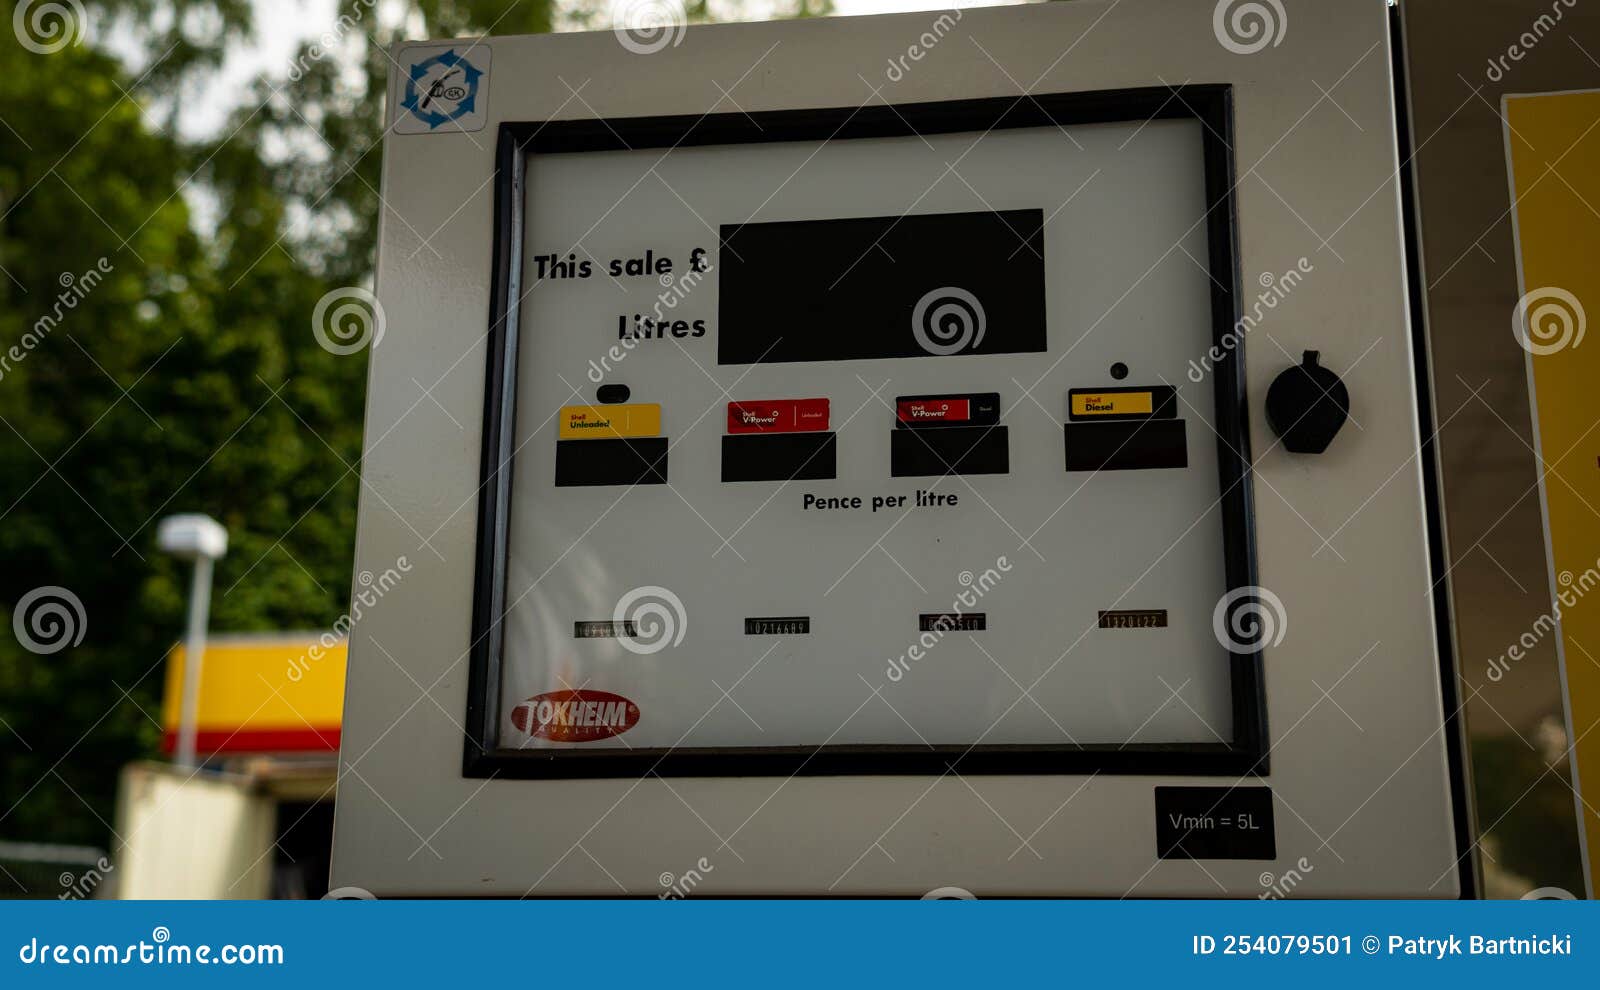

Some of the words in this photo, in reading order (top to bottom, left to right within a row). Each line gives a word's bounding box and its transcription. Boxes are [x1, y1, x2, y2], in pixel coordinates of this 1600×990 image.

[534, 253, 592, 279] This
[609, 250, 672, 277] sale
[618, 314, 706, 340] Litres
[1085, 403, 1113, 411] Diesel
[570, 420, 610, 428] Unleaded
[803, 493, 862, 510] Pence
[872, 495, 907, 512] per
[916, 490, 958, 507] litre
[1169, 813, 1214, 829] Vmin
[1220, 817, 1231, 825] =
[1237, 813, 1260, 830] 5L
